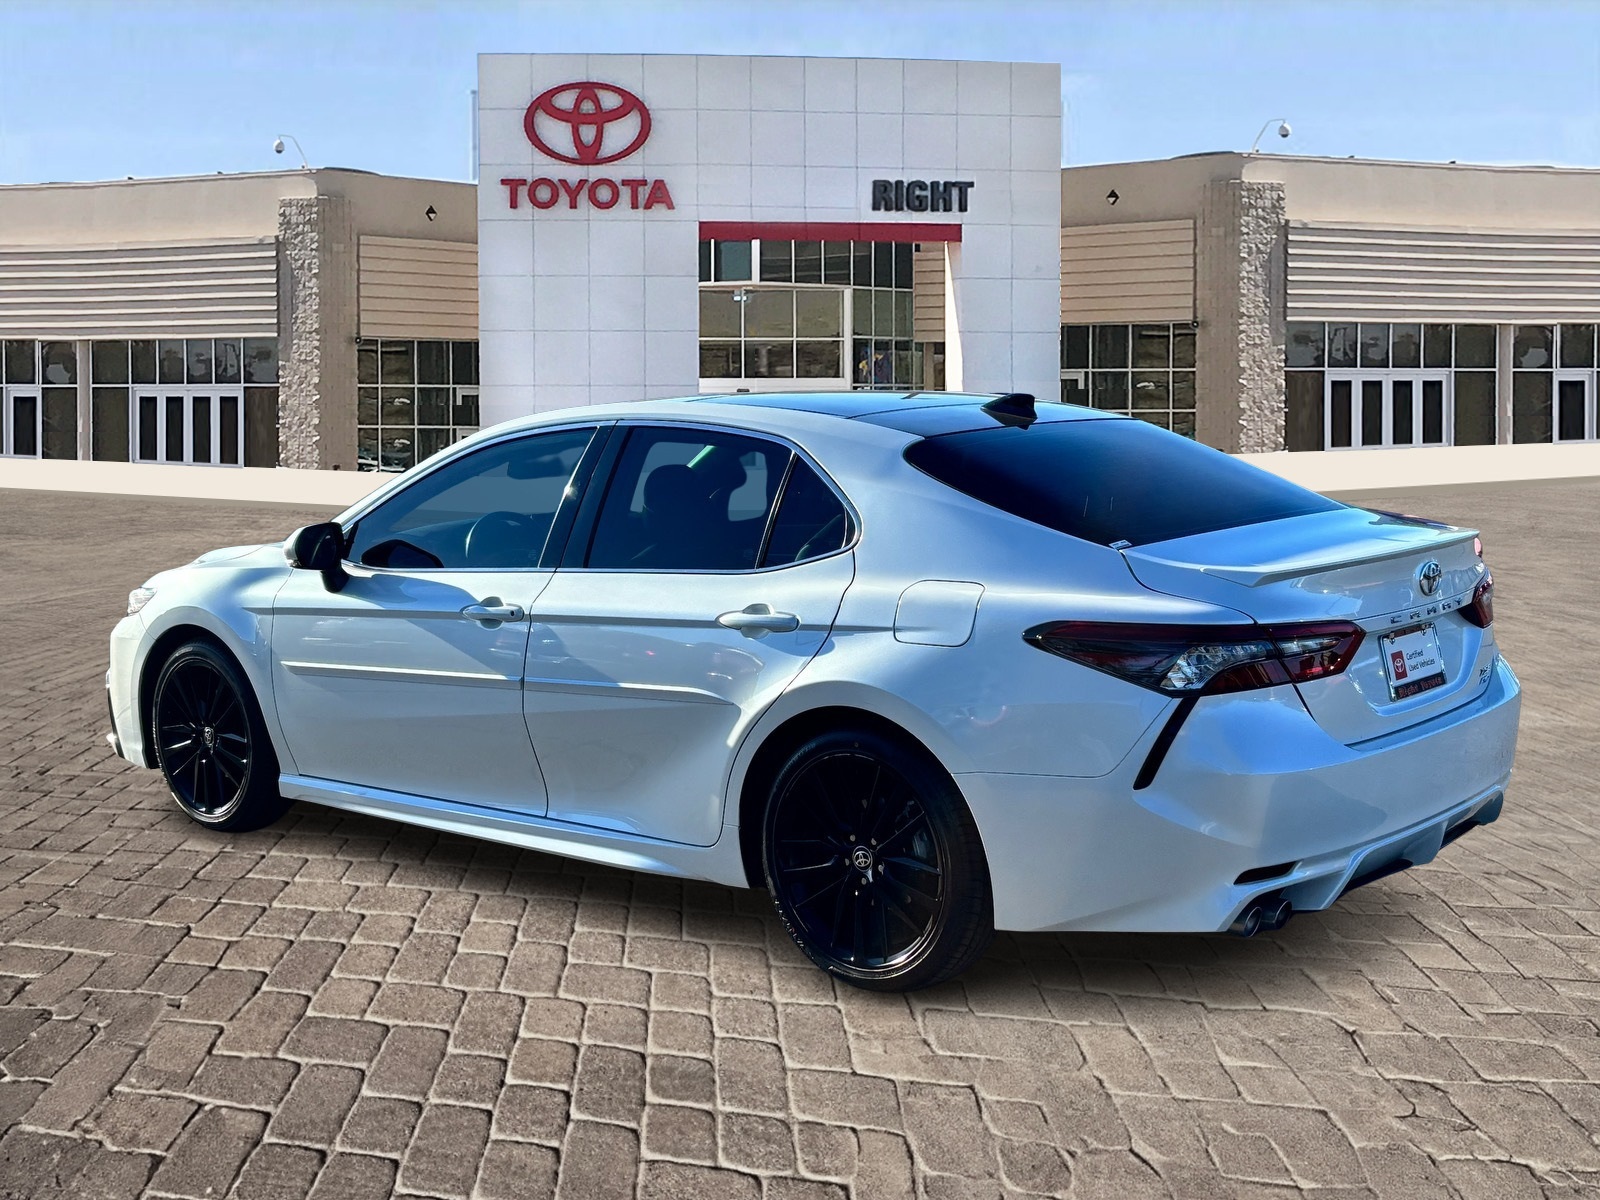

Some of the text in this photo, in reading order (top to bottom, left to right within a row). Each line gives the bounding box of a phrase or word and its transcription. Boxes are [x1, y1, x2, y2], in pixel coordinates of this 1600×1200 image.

[501, 179, 674, 210] TOYOTA
[872, 179, 975, 212] RIGHT
[1391, 598, 1462, 624] CAMRY
[1406, 649, 1424, 661] Certified
[1409, 659, 1435, 672] Used Vehicles
[1421, 677, 1442, 691] Toyota
